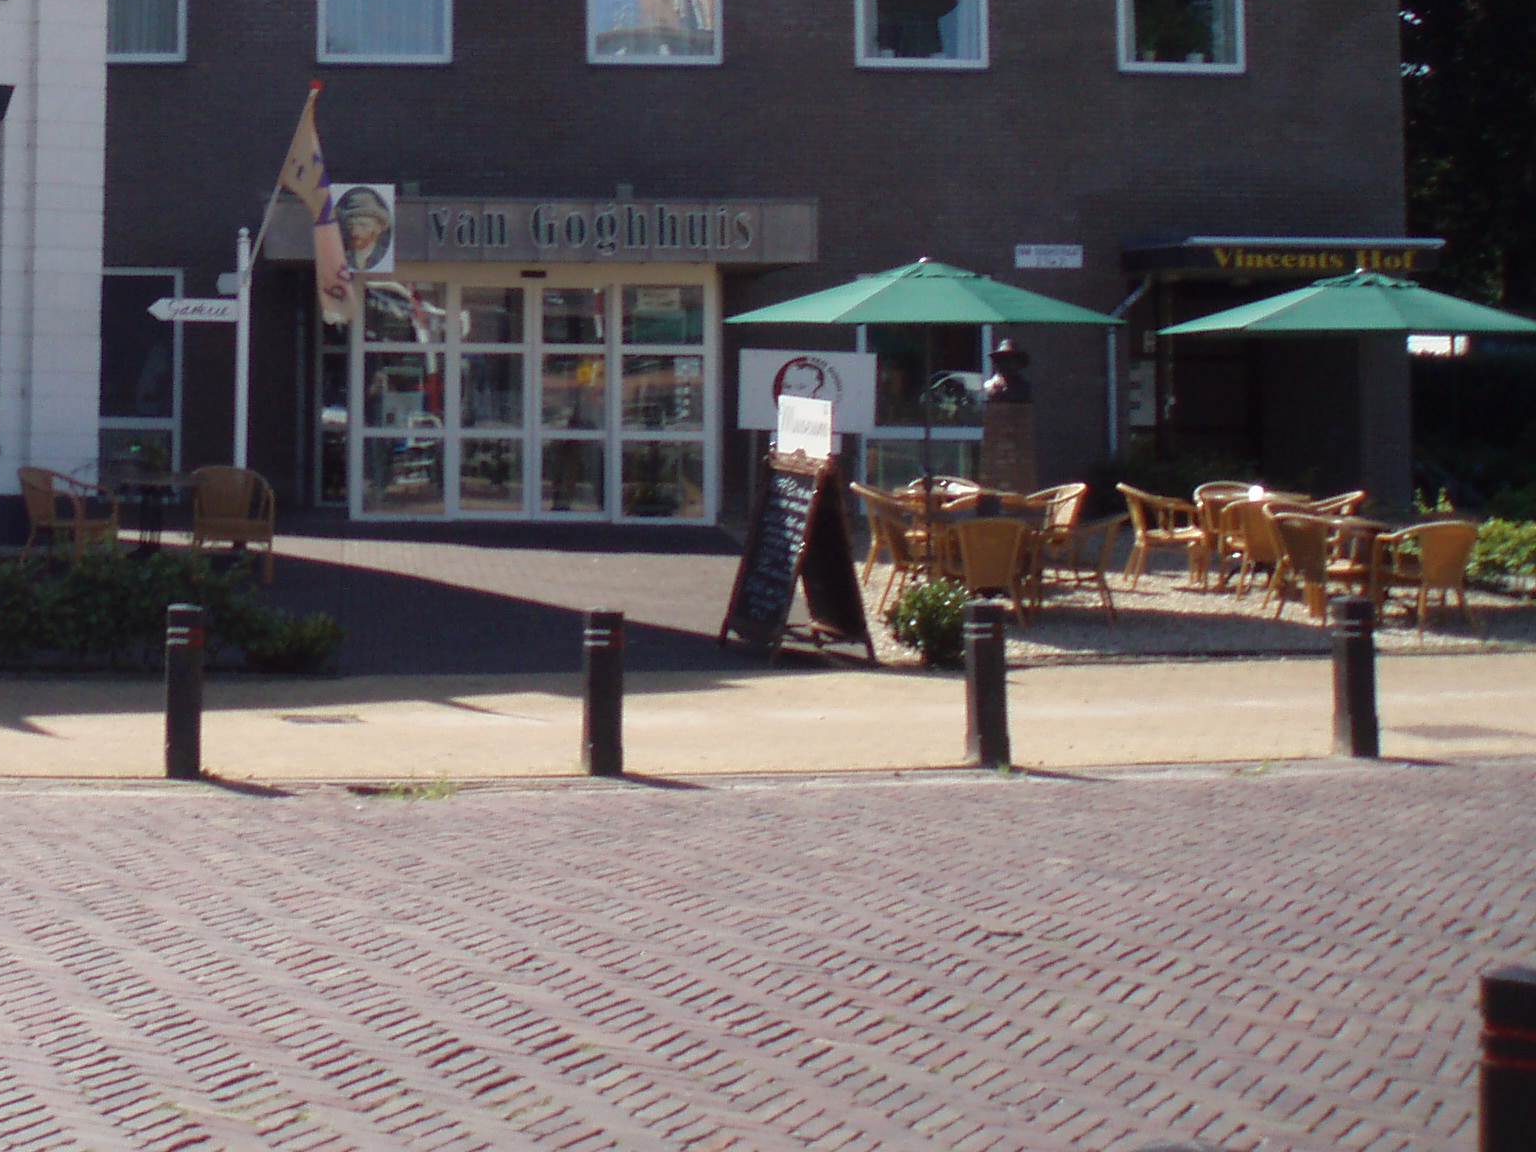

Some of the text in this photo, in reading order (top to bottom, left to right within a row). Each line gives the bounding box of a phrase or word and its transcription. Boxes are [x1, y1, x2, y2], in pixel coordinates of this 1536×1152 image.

[529, 201, 754, 257] Goghhuis
[1214, 247, 1417, 270] Vincents Hof
